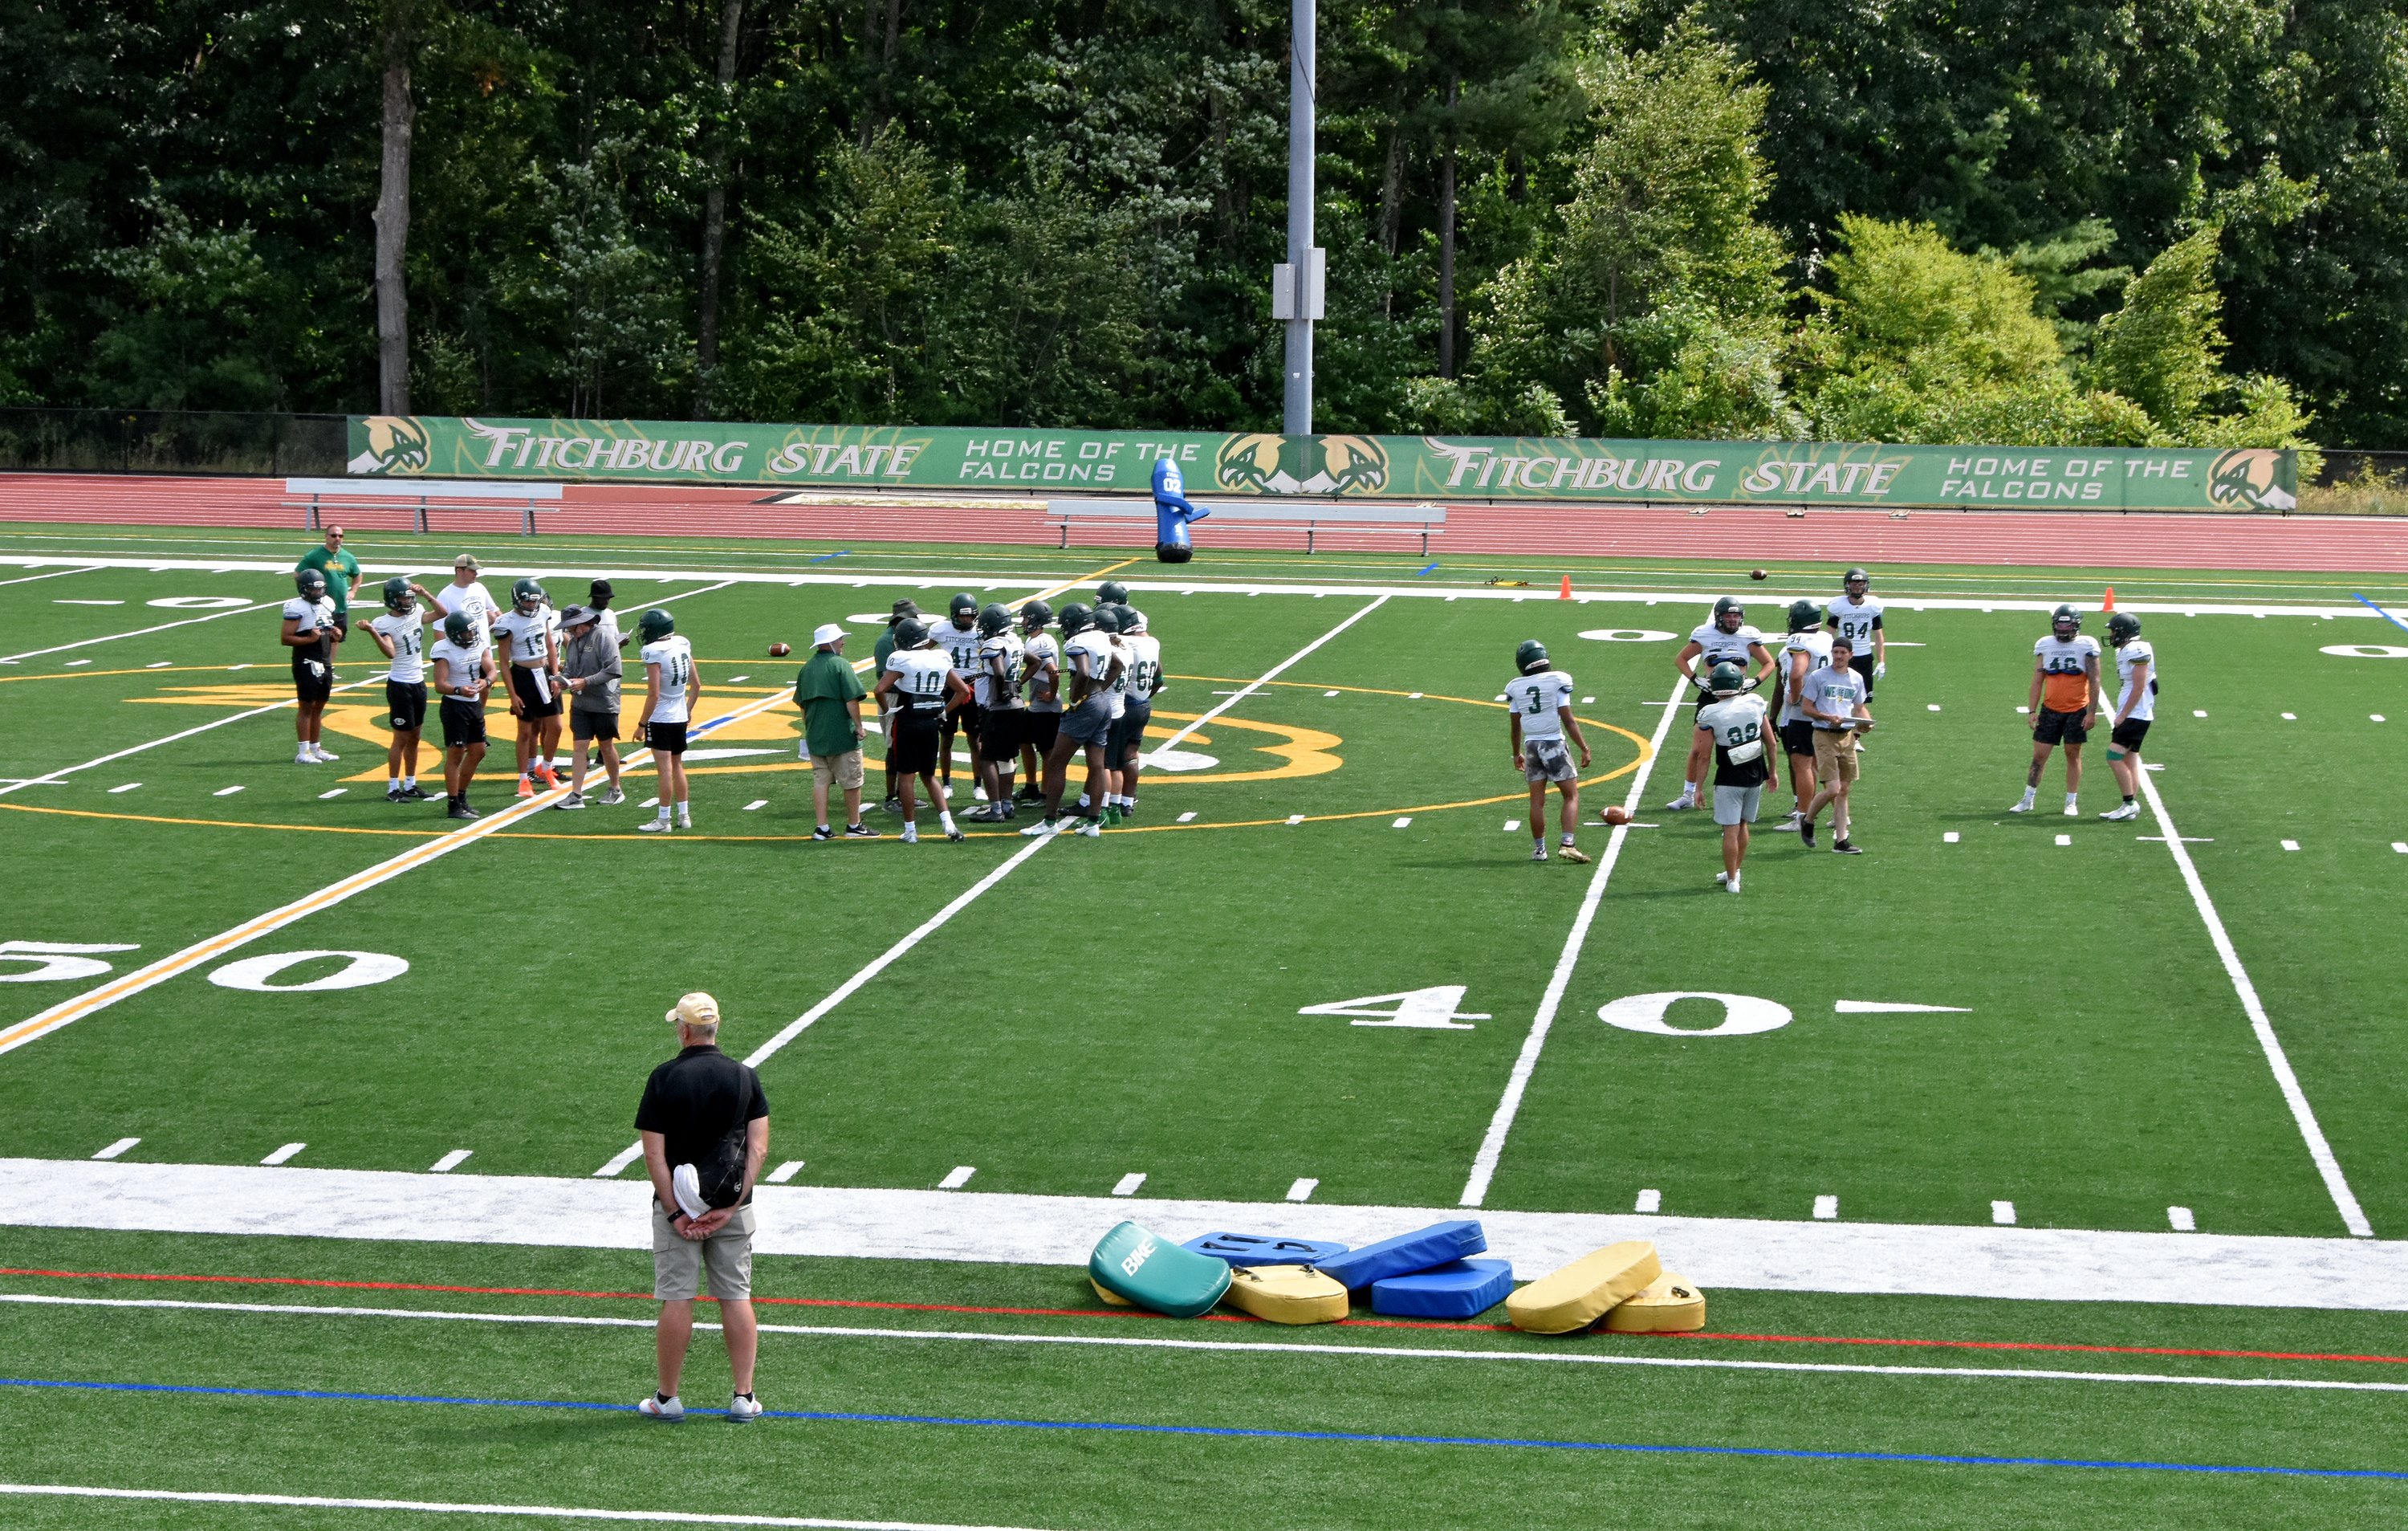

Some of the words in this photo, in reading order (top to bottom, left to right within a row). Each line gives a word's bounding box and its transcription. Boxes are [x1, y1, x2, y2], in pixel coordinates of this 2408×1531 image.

[462, 418, 749, 474] FITCHBURG
[769, 442, 921, 477] STATE
[966, 440, 1065, 460] HOME
[1079, 441, 1125, 461] OF
[1135, 442, 1202, 462] THE
[959, 461, 1118, 482] FALCONS
[1423, 437, 1721, 492] FITCHBURG
[1743, 460, 1902, 495] STATE
[1947, 458, 2050, 478] HOME
[2065, 459, 2112, 478] OF
[2125, 460, 2194, 479] THE
[1163, 478, 1182, 494] 02
[1939, 480, 2103, 501] FALCONS
[402, 628, 423, 655] 13
[1843, 622, 1869, 639] 84
[525, 633, 545, 657] 15
[950, 646, 971, 668] 41
[915, 670, 941, 693] 10
[1526, 686, 1541, 714] 3
[1121, 1237, 1156, 1277] BIKE
